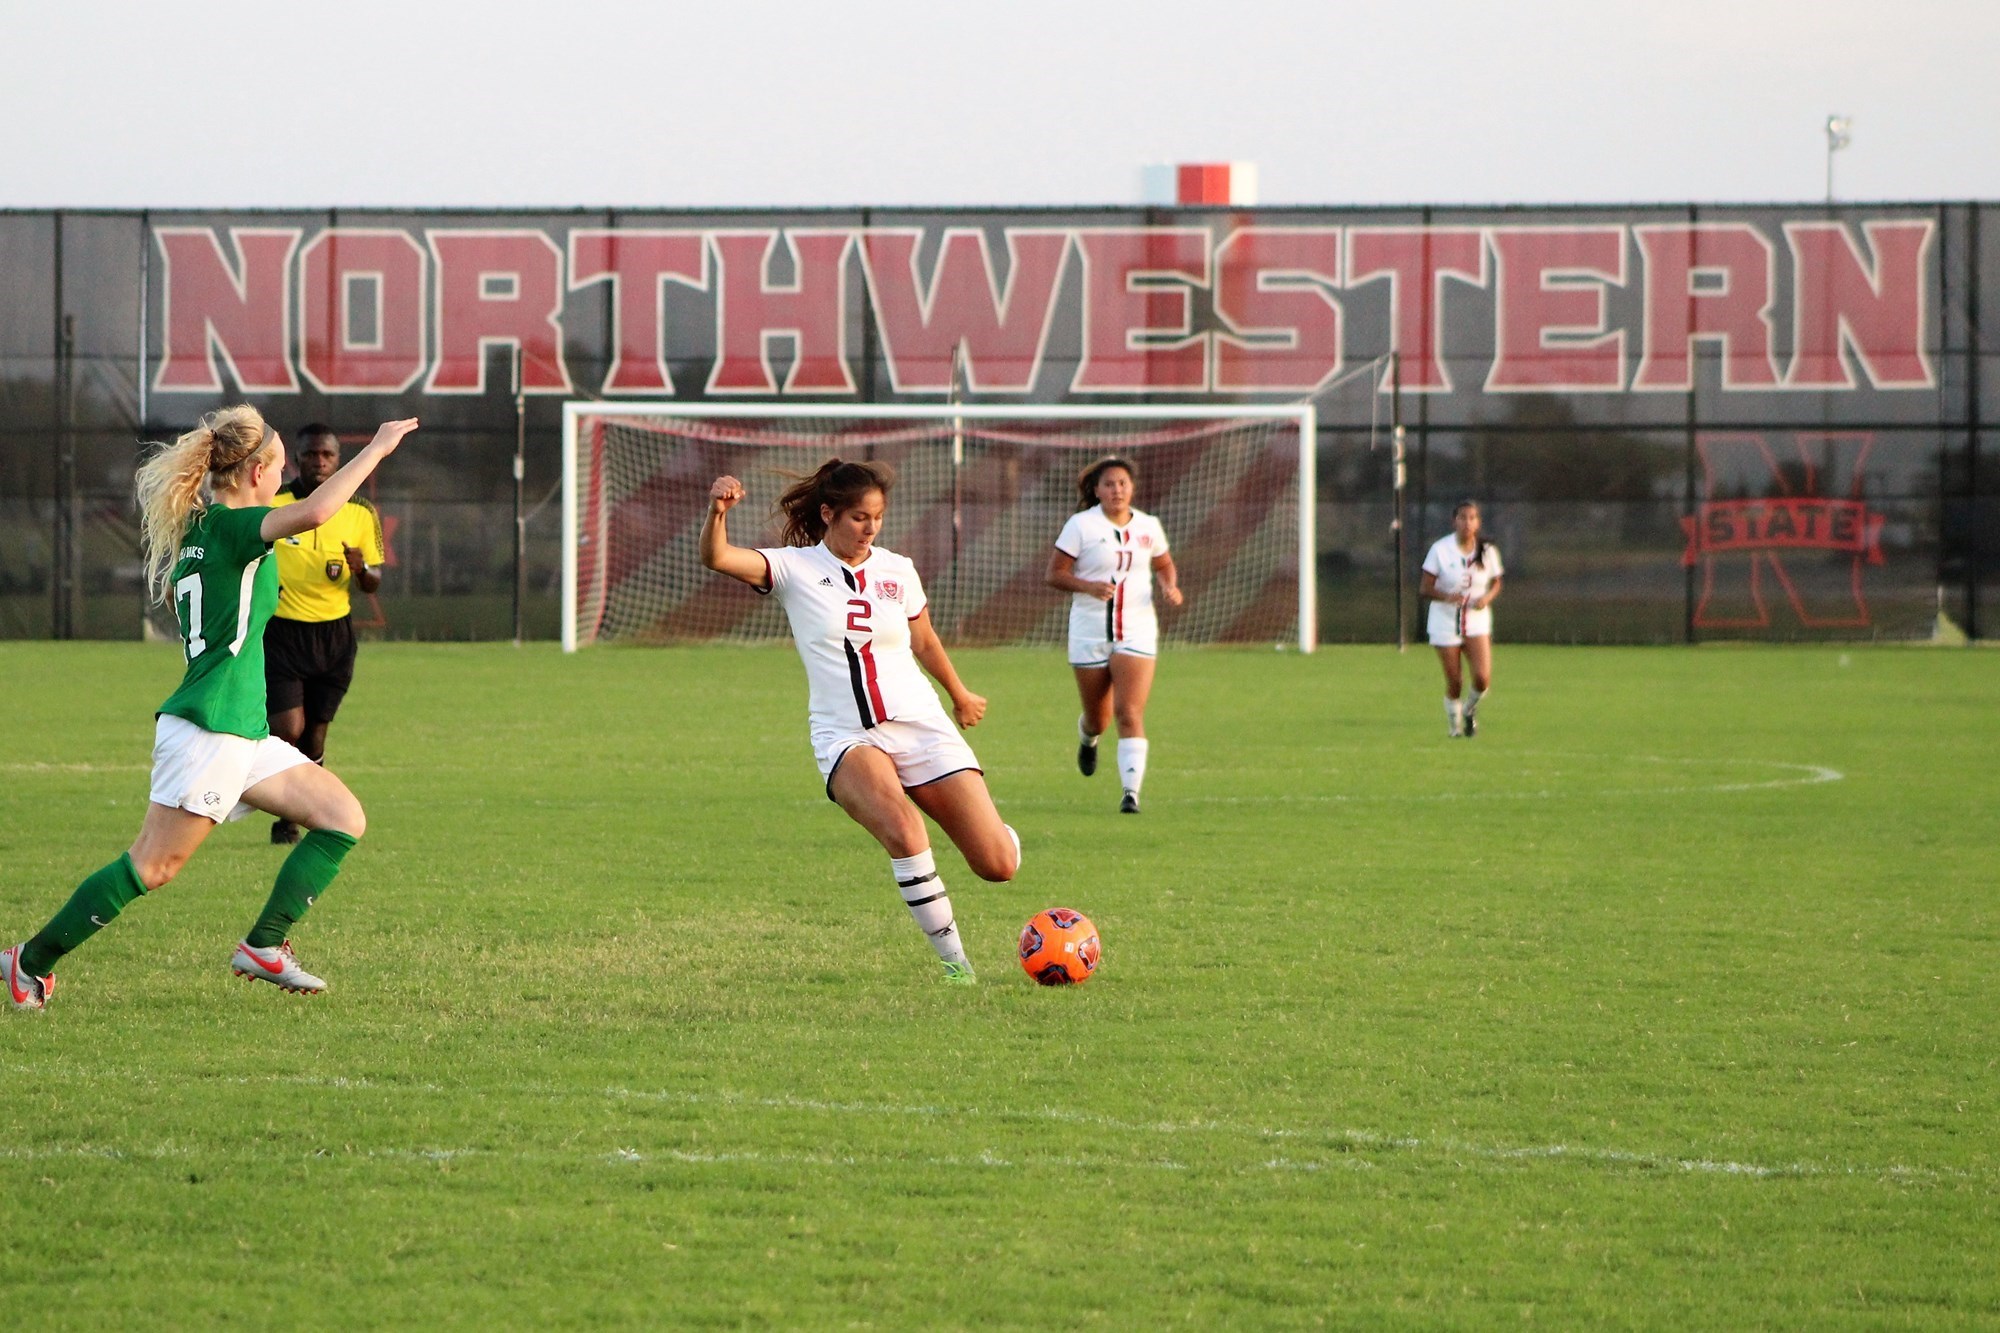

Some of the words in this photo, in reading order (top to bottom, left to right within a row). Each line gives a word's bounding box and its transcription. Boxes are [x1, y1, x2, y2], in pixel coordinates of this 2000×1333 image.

[152, 219, 1937, 395] NORTHWESTERN
[1707, 504, 1858, 543] STATE
[174, 572, 207, 665] 7
[847, 599, 873, 633] 2
